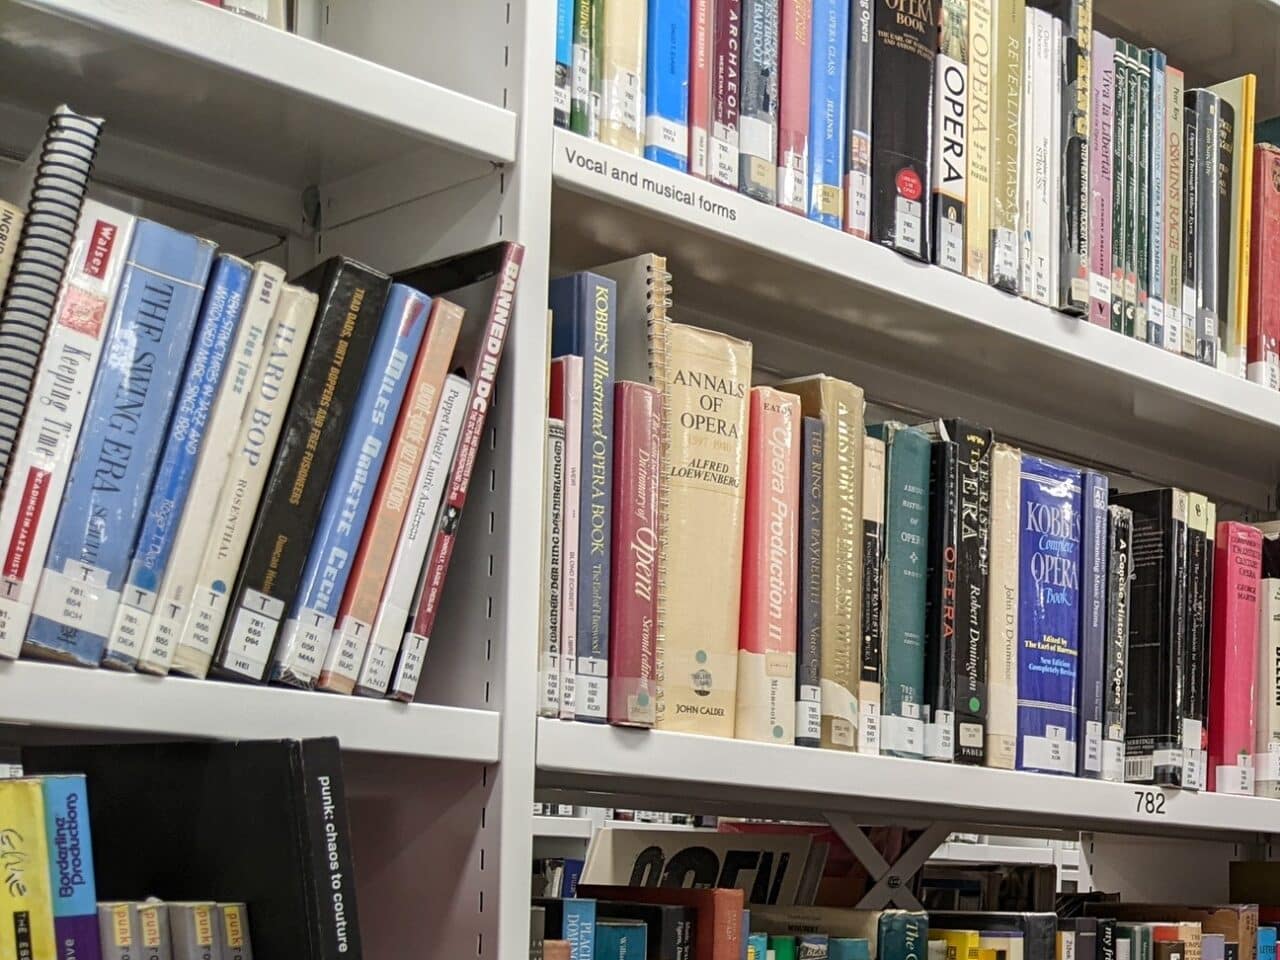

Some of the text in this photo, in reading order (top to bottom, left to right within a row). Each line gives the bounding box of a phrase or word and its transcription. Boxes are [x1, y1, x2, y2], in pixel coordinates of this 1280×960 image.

[896, 13, 927, 33] BOOK
[1006, 36, 1020, 147] REVEALING
[943, 65, 966, 183] OPERA
[565, 147, 737, 221] Vocal and musical forms
[90, 223, 114, 276] Walser
[472, 264, 519, 414] BANNED IN DC
[40, 344, 92, 412] Keeping
[91, 283, 175, 494] THE SWING ERA
[591, 355, 609, 438] Illustrated
[673, 369, 745, 399] ANNALS
[699, 394, 723, 413] OF
[217, 322, 296, 559] HARD BOP ROSENTHAL
[438, 389, 459, 431] Puppet
[680, 412, 739, 440] OPERA
[591, 440, 606, 499] OPERA
[671, 467, 740, 488] LOEWENBERG
[688, 458, 729, 474] ALFRED
[771, 427, 789, 495] Opera
[591, 503, 605, 556] BOOK
[769, 501, 789, 621] Production
[631, 526, 658, 601] Opera
[943, 546, 957, 638] OPERA
[1030, 552, 1079, 591] OPERA
[965, 584, 982, 692] Robert Donington
[1114, 538, 1127, 705] A Concise History of Opera
[675, 703, 725, 717] JOHN CALDER
[1134, 791, 1166, 815] 782
[318, 776, 348, 953] punk: chaos to couture
[906, 922, 920, 951] The
[1102, 926, 1112, 946] my
